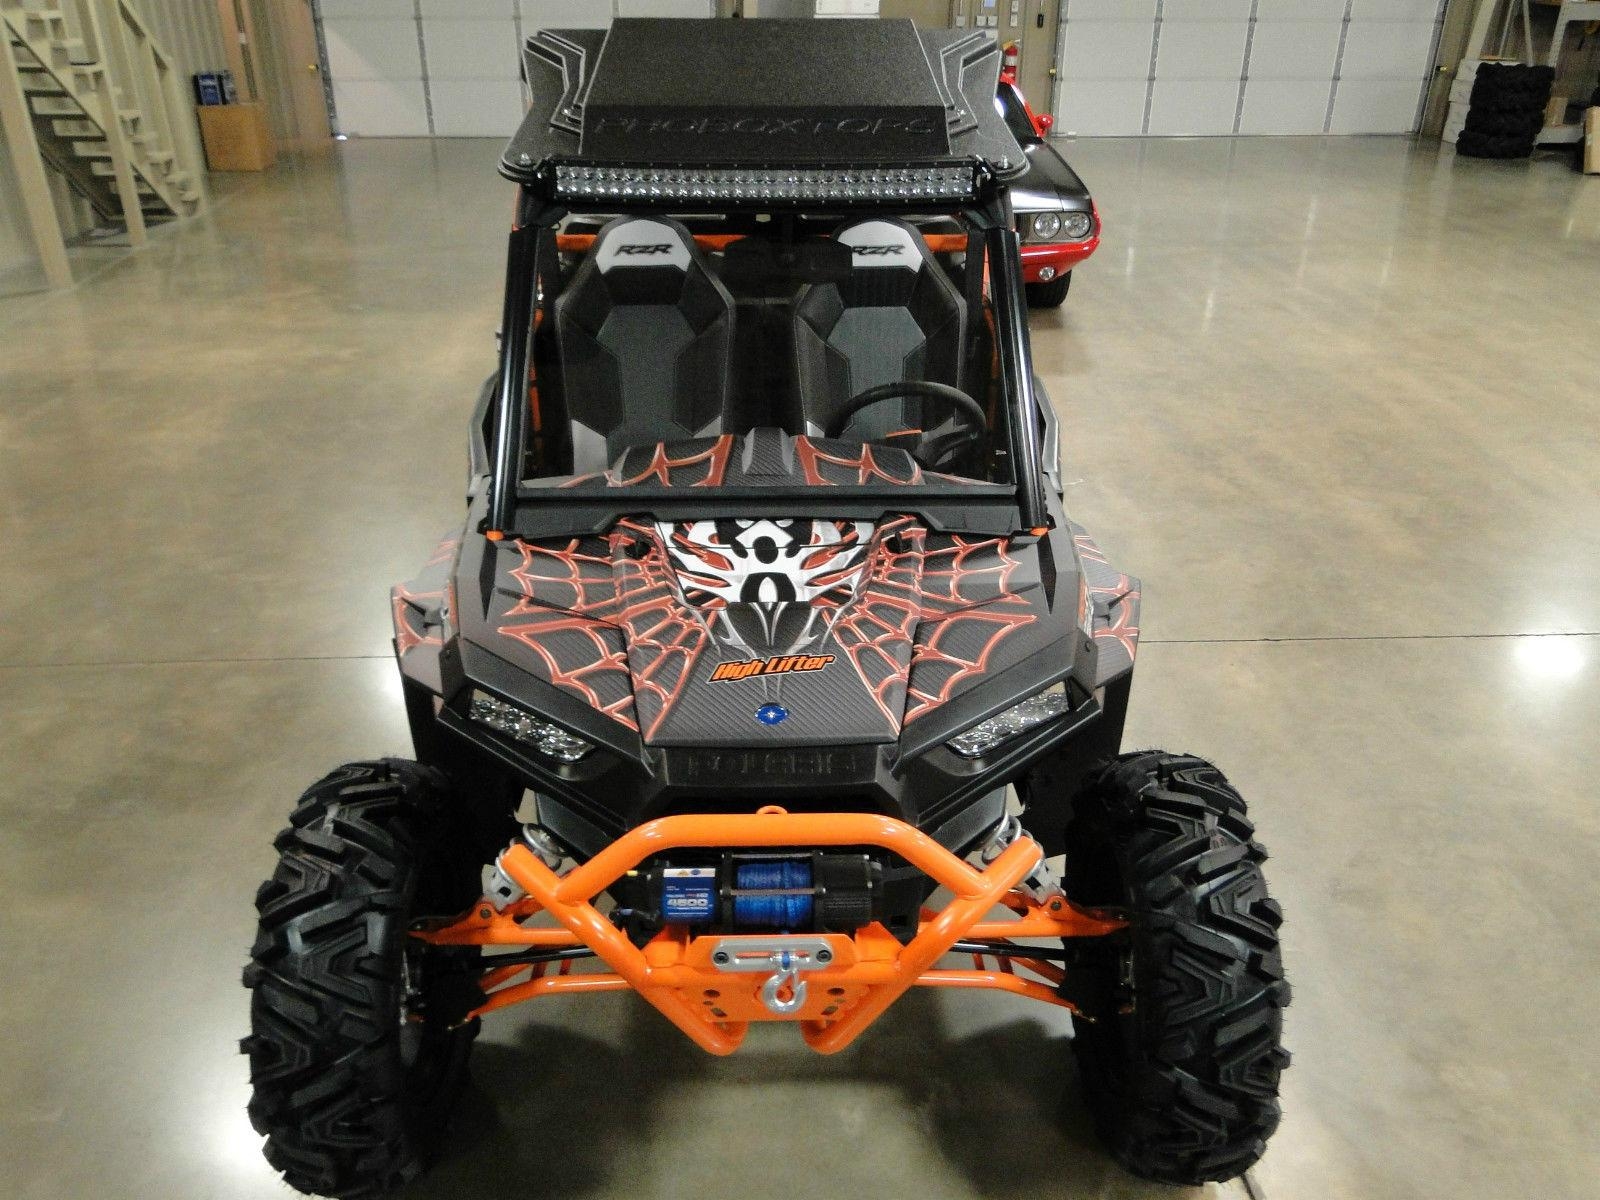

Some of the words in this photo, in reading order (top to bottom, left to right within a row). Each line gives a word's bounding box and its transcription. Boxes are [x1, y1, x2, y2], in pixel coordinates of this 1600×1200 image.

[614, 244, 673, 256] RZR
[710, 658, 764, 682] High
[764, 655, 835, 673] Lifter
